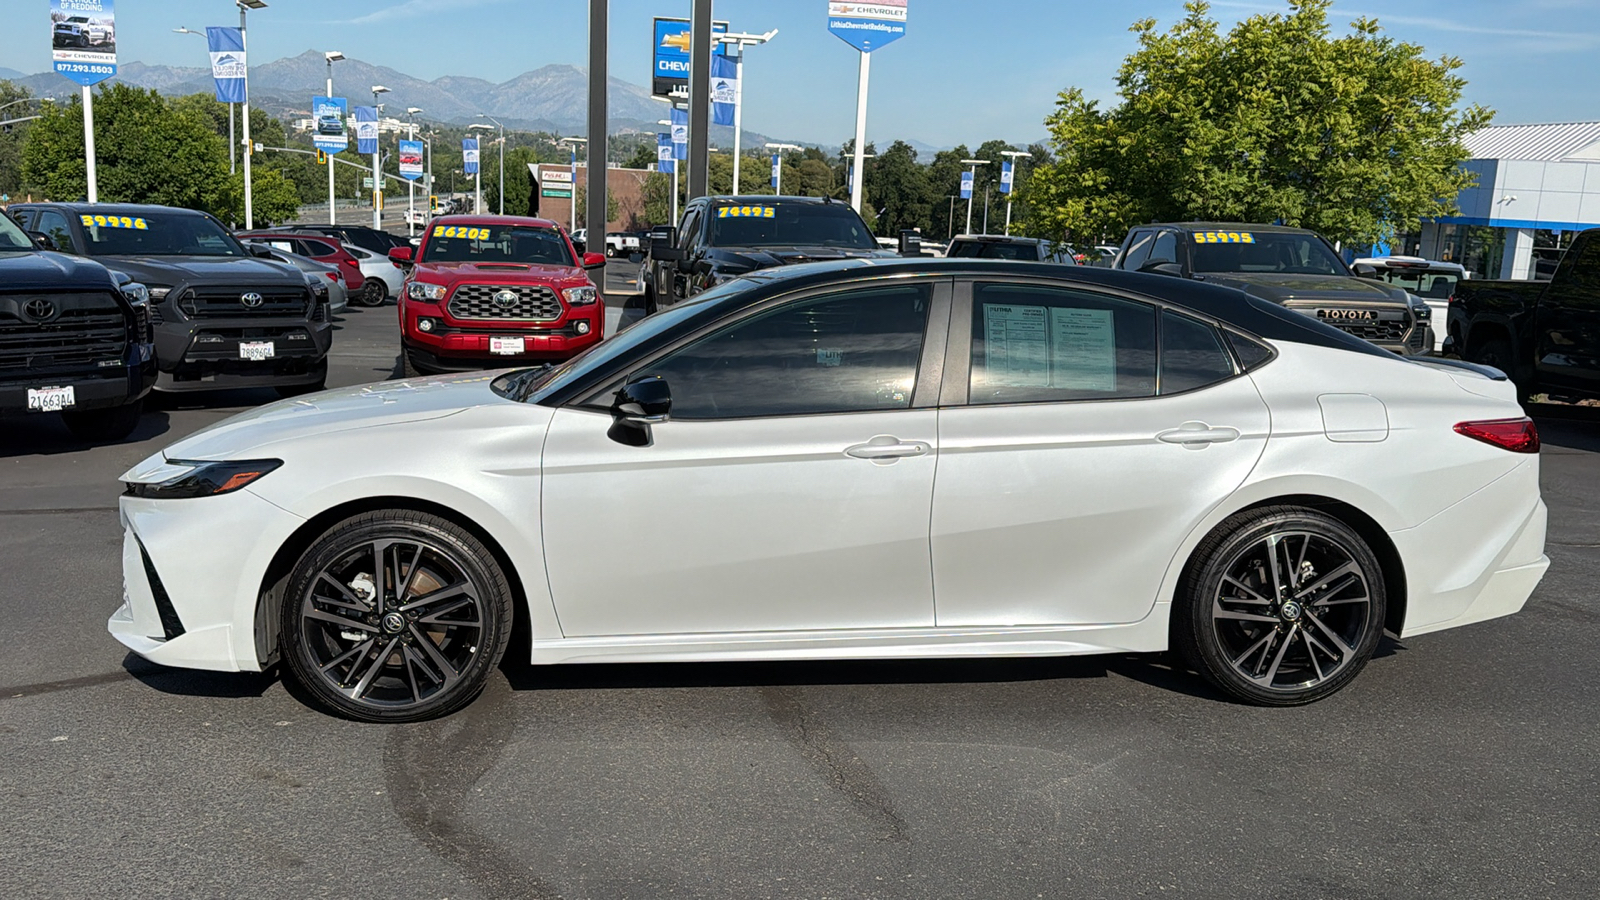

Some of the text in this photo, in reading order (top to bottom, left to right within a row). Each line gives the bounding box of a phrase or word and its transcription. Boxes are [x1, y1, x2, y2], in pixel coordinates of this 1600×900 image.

[71, 4, 103, 12] REDDING
[857, 7, 904, 16] CHEVROLET
[57, 64, 113, 74] 877.293.5503
[719, 206, 774, 218] 74495
[81, 214, 146, 229] 39996
[433, 226, 490, 240] 36205
[1194, 232, 1252, 243] 55995
[1324, 310, 1371, 319] TOYOTA
[241, 347, 272, 359] 78896G4
[30, 393, 73, 408] 21663A4
